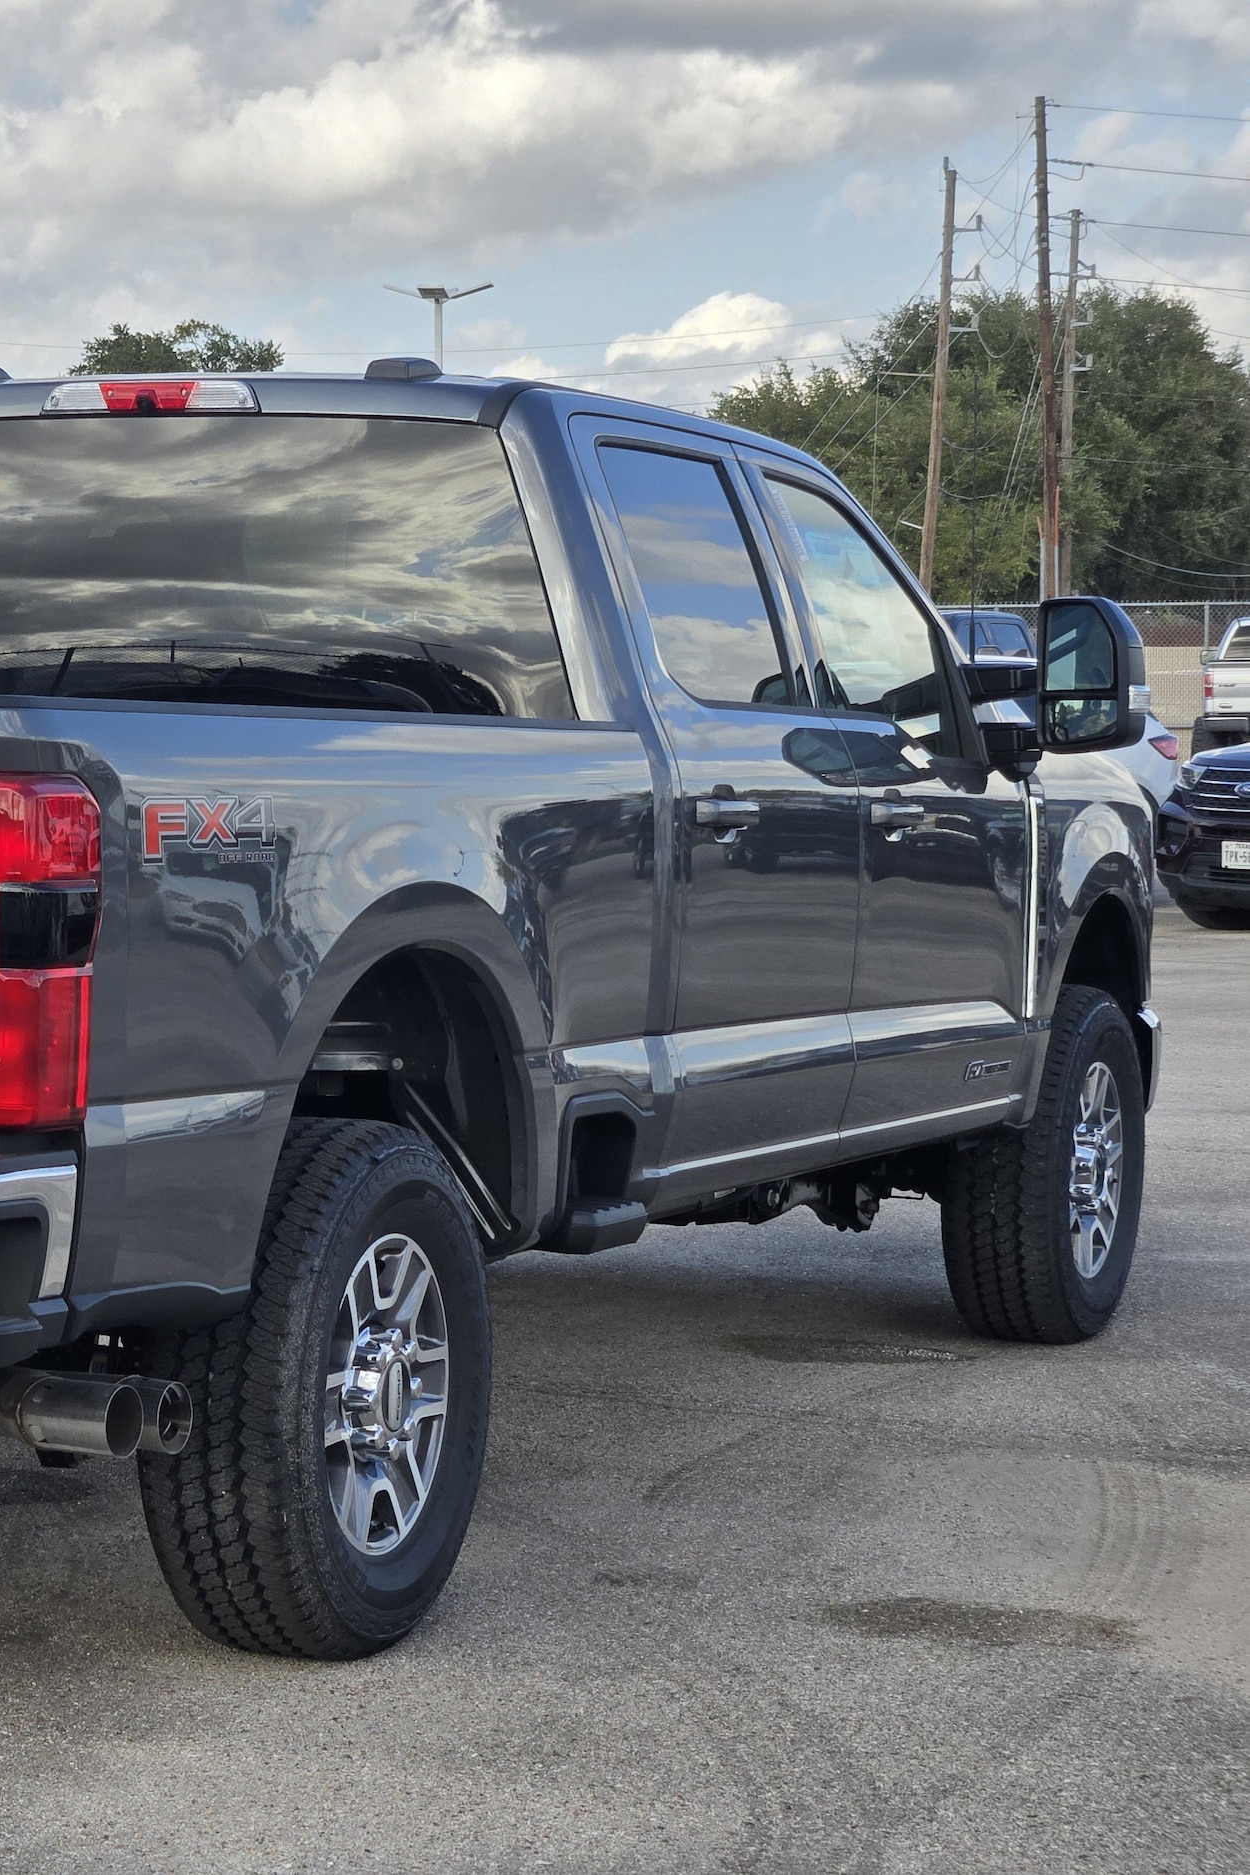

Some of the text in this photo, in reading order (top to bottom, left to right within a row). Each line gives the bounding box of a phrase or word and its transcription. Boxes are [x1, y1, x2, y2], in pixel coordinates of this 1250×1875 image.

[140, 795, 278, 866] FX4
[218, 852, 276, 864] OFF ROAD
